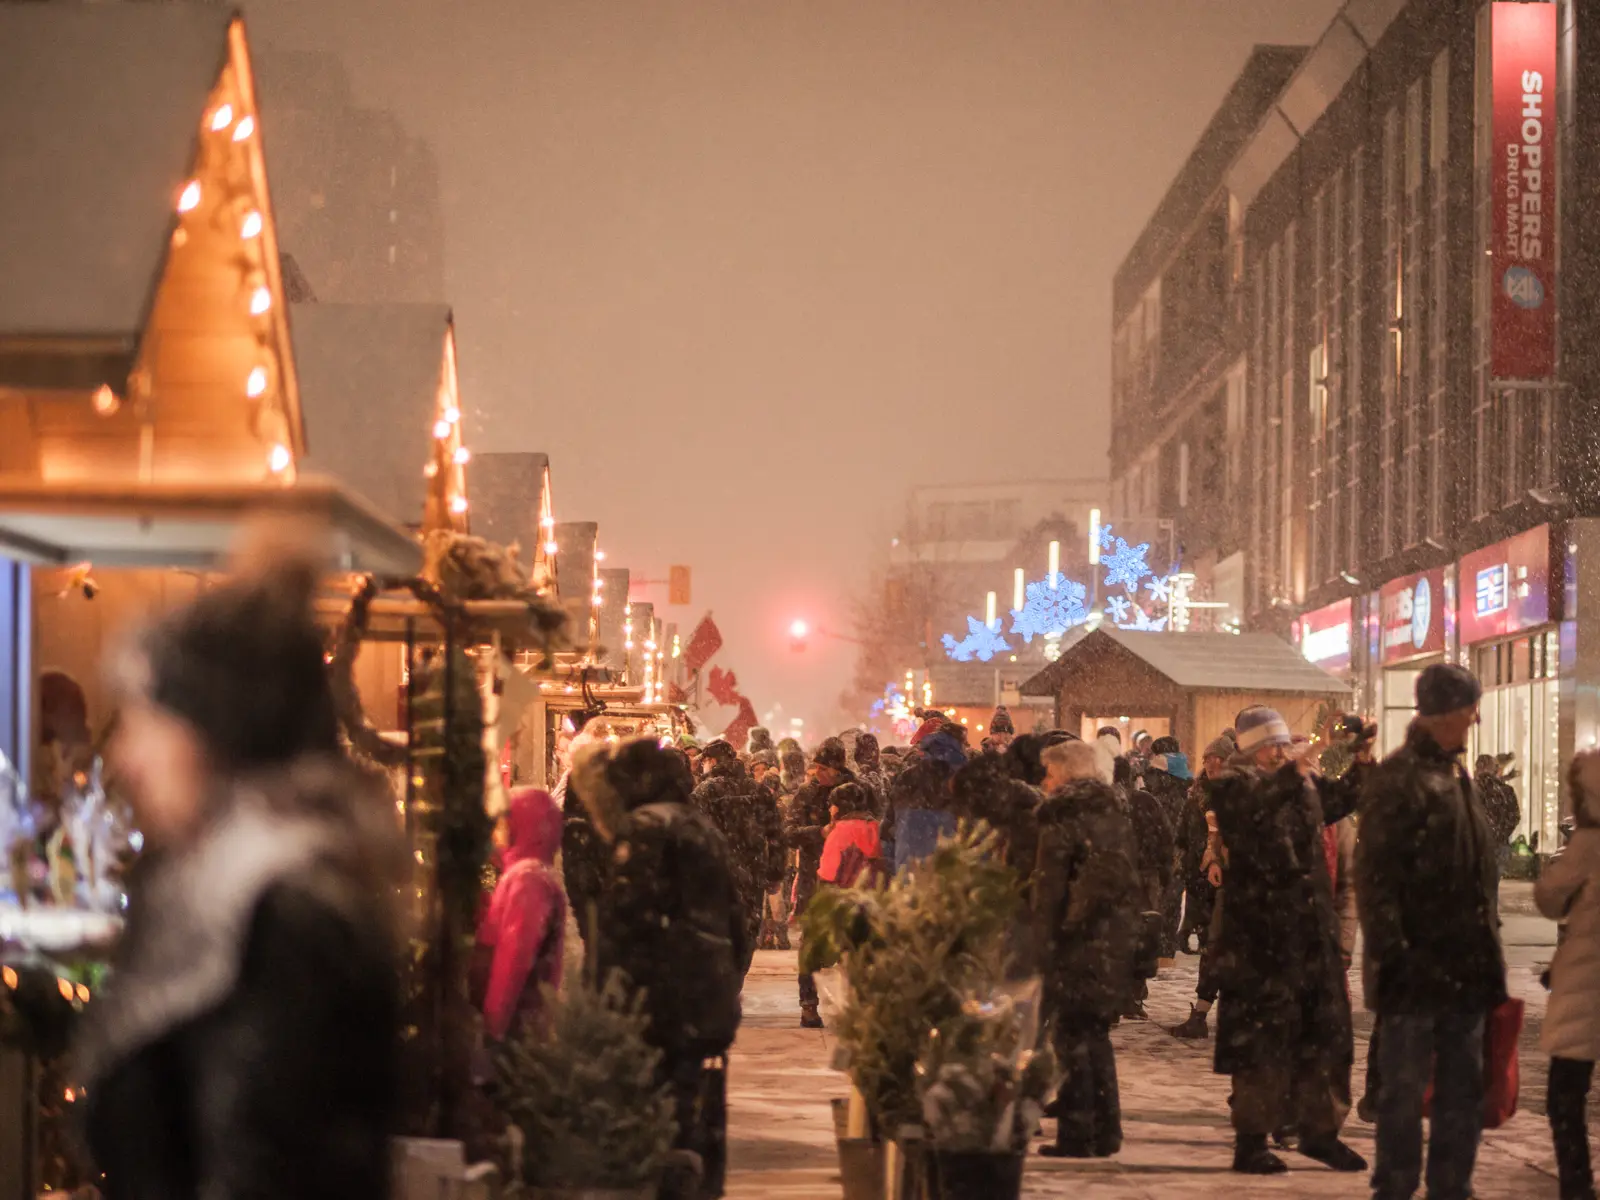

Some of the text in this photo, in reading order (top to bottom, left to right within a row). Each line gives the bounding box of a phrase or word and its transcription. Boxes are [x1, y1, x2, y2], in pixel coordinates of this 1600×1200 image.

[1506, 143, 1519, 257] DRUG MART
[1521, 69, 1543, 260] SHOPPERS
